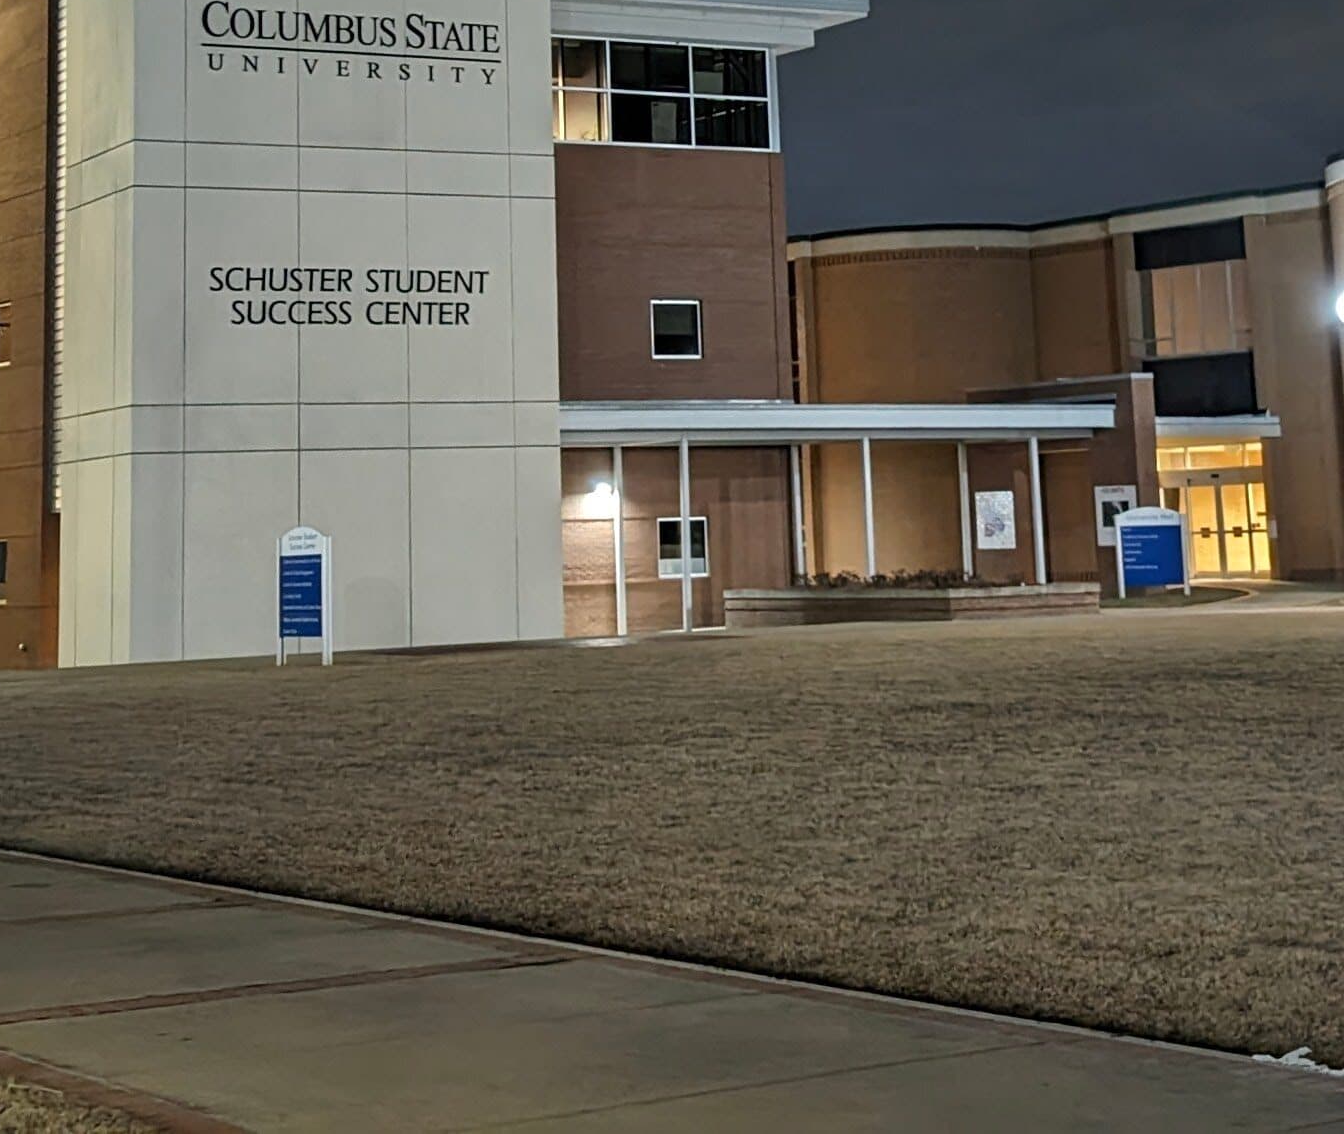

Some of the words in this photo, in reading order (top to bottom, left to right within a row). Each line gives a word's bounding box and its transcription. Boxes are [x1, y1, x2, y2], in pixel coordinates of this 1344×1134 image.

[207, 53, 496, 85] UNIVERSITY
[209, 267, 353, 292] SCHUSTER
[365, 269, 490, 294] STUDENT
[231, 300, 353, 325] SUCCESS
[365, 302, 470, 325] CENTER
